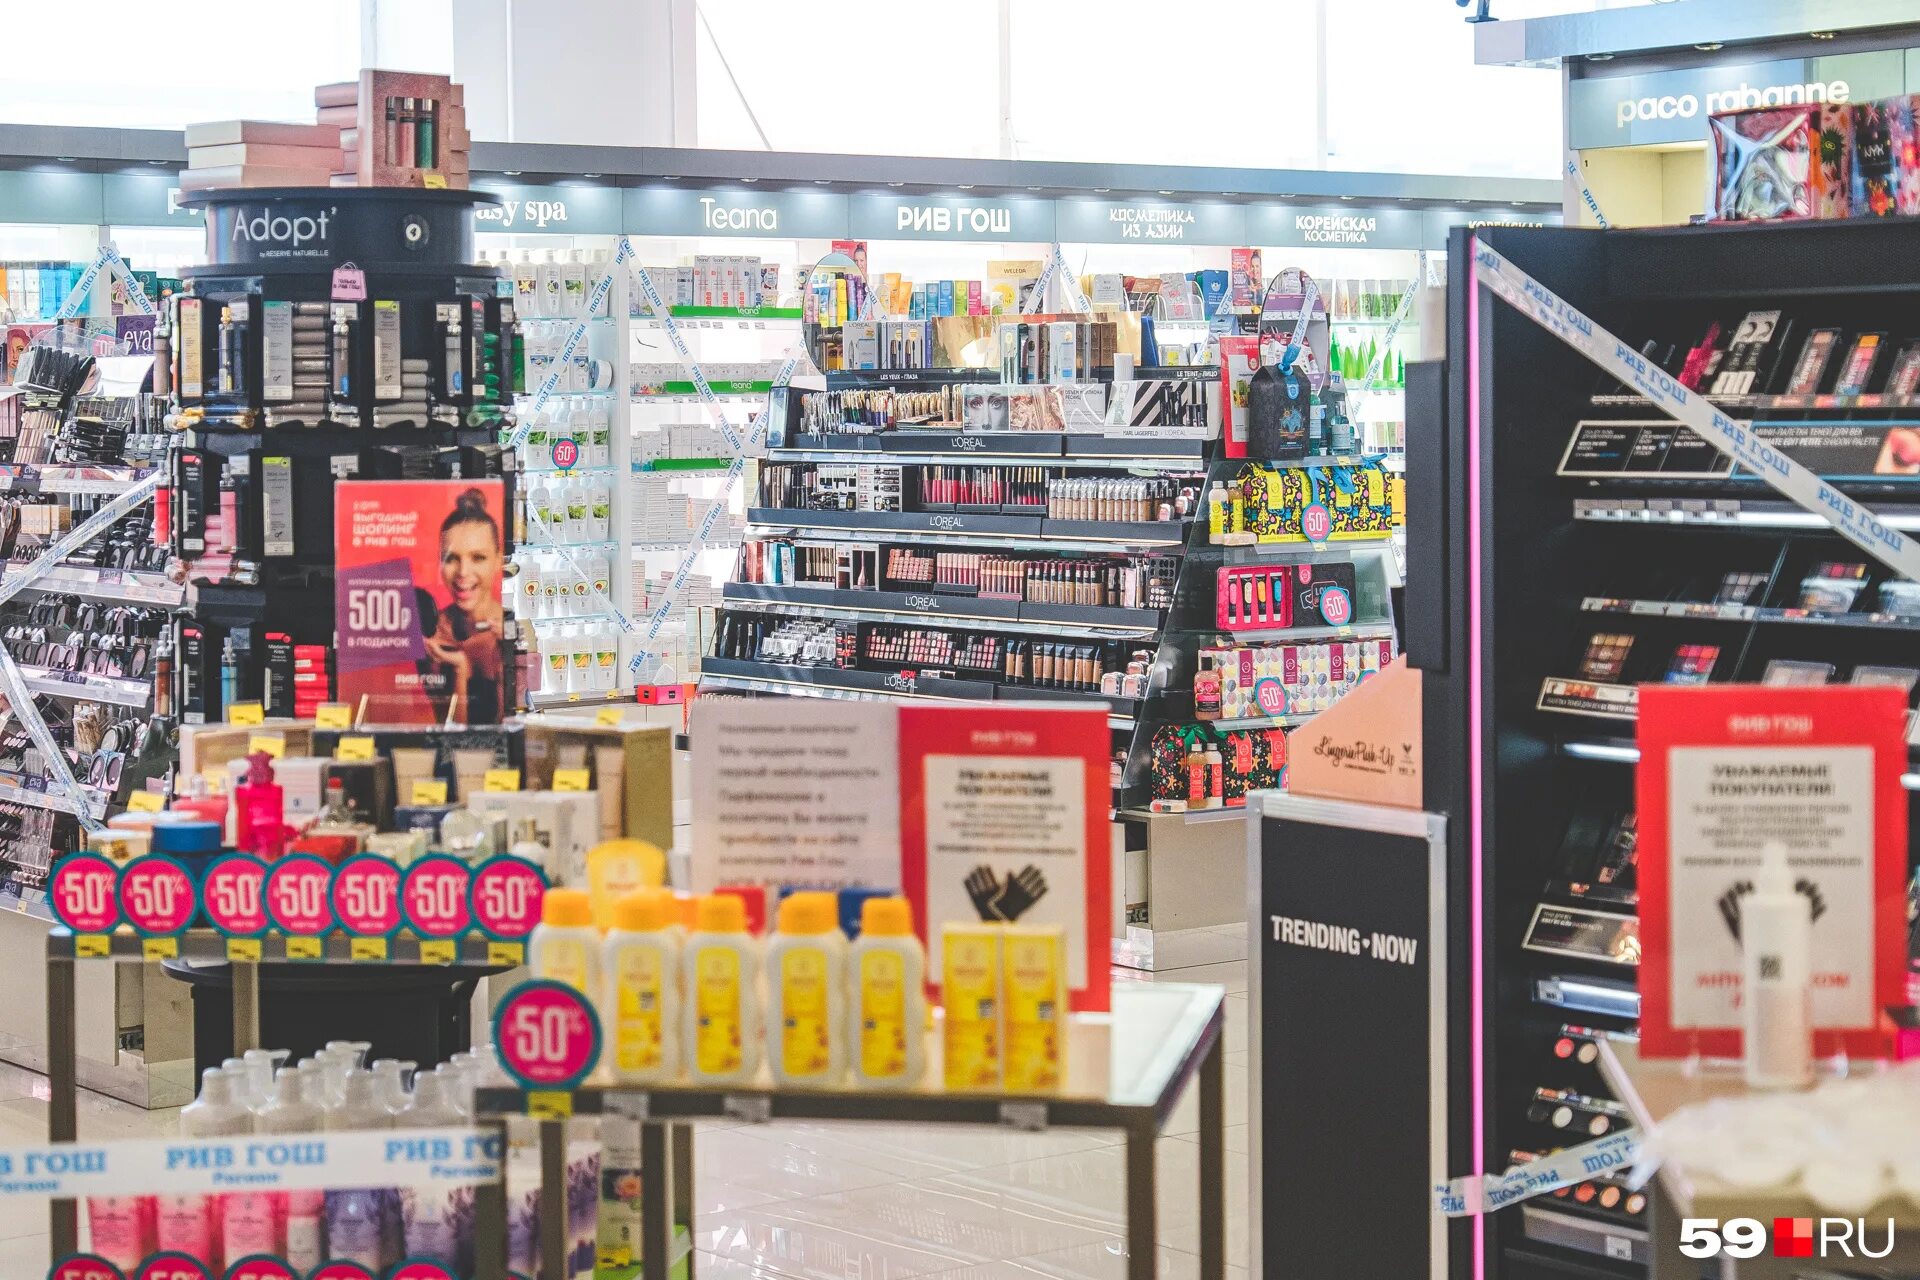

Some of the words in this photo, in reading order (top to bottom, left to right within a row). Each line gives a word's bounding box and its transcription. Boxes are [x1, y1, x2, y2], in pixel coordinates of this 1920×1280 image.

[1617, 92, 1698, 128] paco
[1706, 80, 1850, 115] rabanne
[474, 201, 519, 227] asy
[526, 200, 567, 227] spa
[700, 197, 778, 230] Teana
[898, 206, 951, 232] РИВ
[957, 207, 1010, 232] ГОШ
[1109, 208, 1195, 224] КОСМЕТИКА
[1296, 215, 1376, 232] КОРЕЙСКАЯ
[1122, 224, 1141, 238] ИЗ
[1145, 224, 1183, 239] АЗИИ
[1304, 230, 1367, 243] КОСМЕТИКА
[124, 274, 140, 294] РИВ
[136, 291, 153, 314] ГОШ
[123, 329, 152, 351] eva
[731, 379, 754, 389] Teana
[1524, 278, 1554, 307] РИВ
[1558, 303, 1593, 337] ГОШ
[1616, 343, 1647, 374] РИВ
[1650, 370, 1688, 405] ГОШ
[1712, 412, 1745, 445] РИВ
[1751, 438, 1790, 477] ГОШ
[1818, 486, 1854, 518] РИВ
[1859, 512, 1904, 552] ГОШ
[951, 437, 986, 448] L'ORÉAL
[930, 515, 964, 527] L'ORÉAL
[905, 595, 939, 608] L'ORÉAL
[1271, 914, 1361, 956] TRENDING
[1372, 932, 1418, 965] NOW
[165, 1144, 233, 1170] РИВ
[246, 1141, 326, 1167] ГОШ
[384, 1137, 452, 1163] РИВ
[463, 1135, 502, 1160] ГО
[24, 1150, 106, 1175] ГОШ
